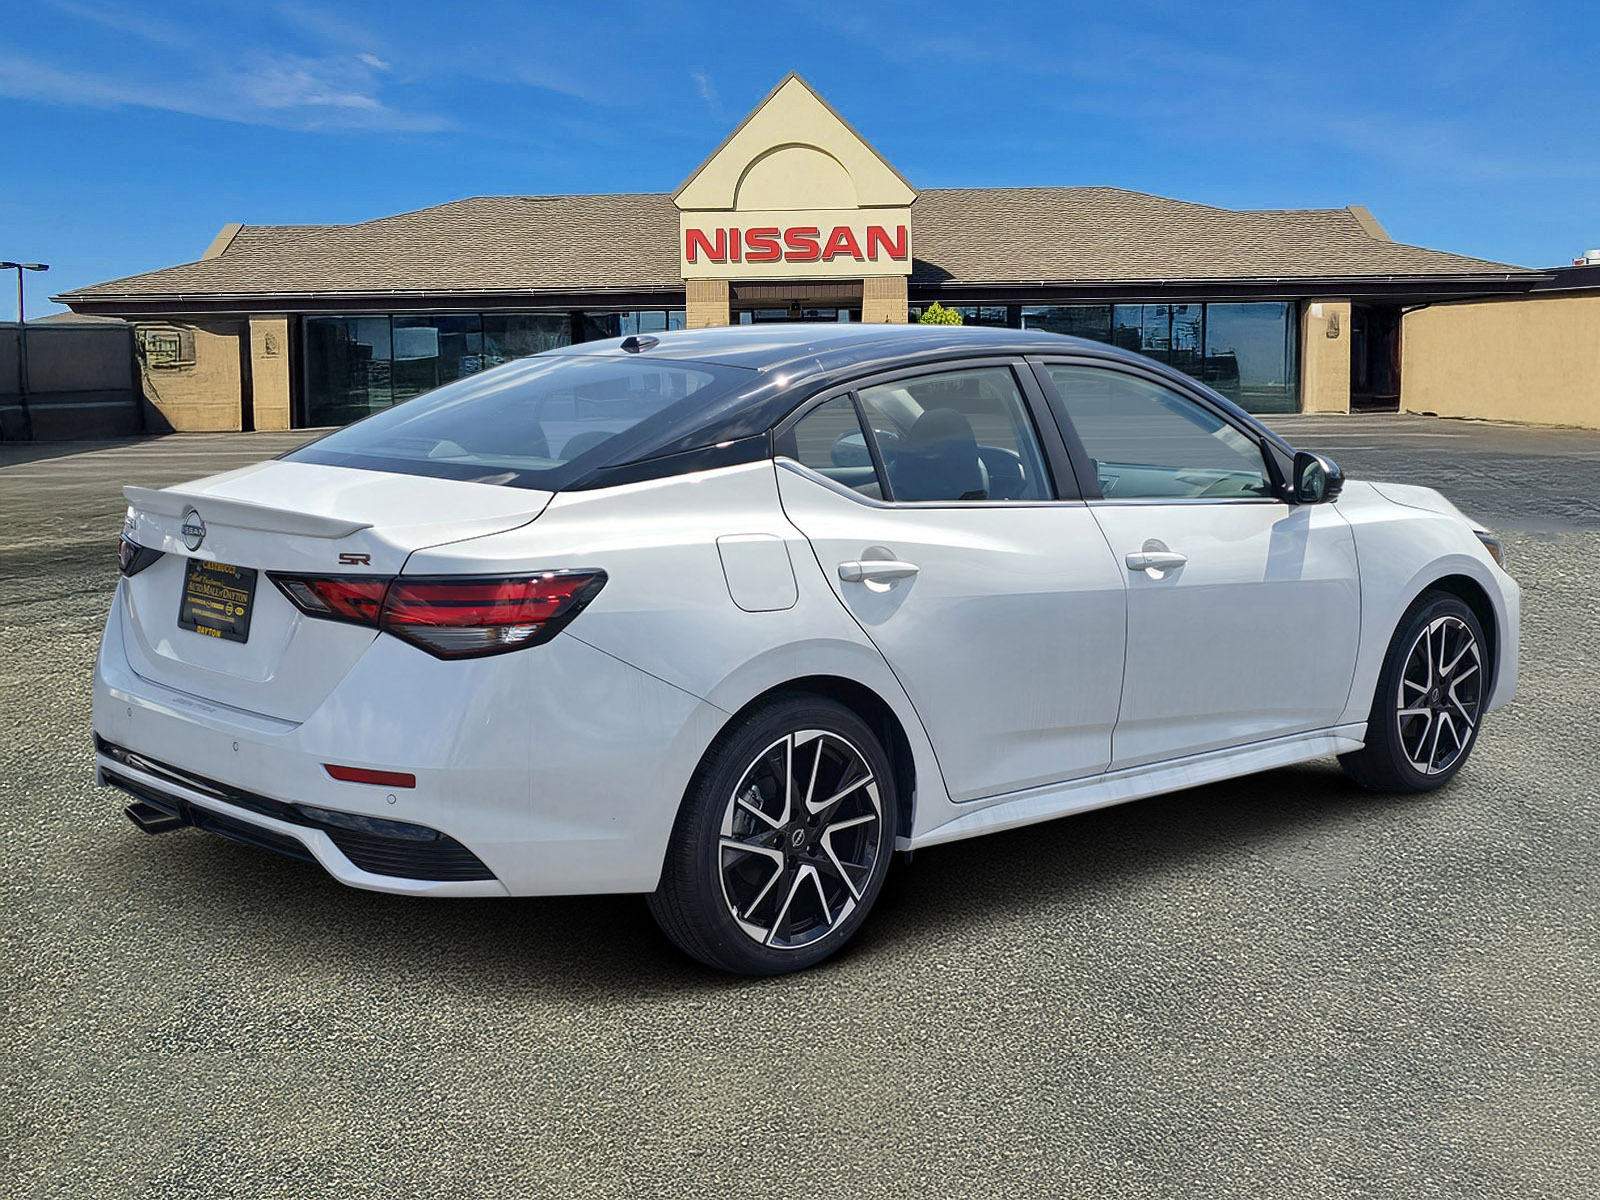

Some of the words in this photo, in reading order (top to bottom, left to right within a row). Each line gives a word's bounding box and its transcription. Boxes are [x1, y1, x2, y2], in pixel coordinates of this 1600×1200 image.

[685, 225, 908, 263] NISSAN
[338, 553, 371, 566] SR
[196, 625, 222, 638] DAYTON
